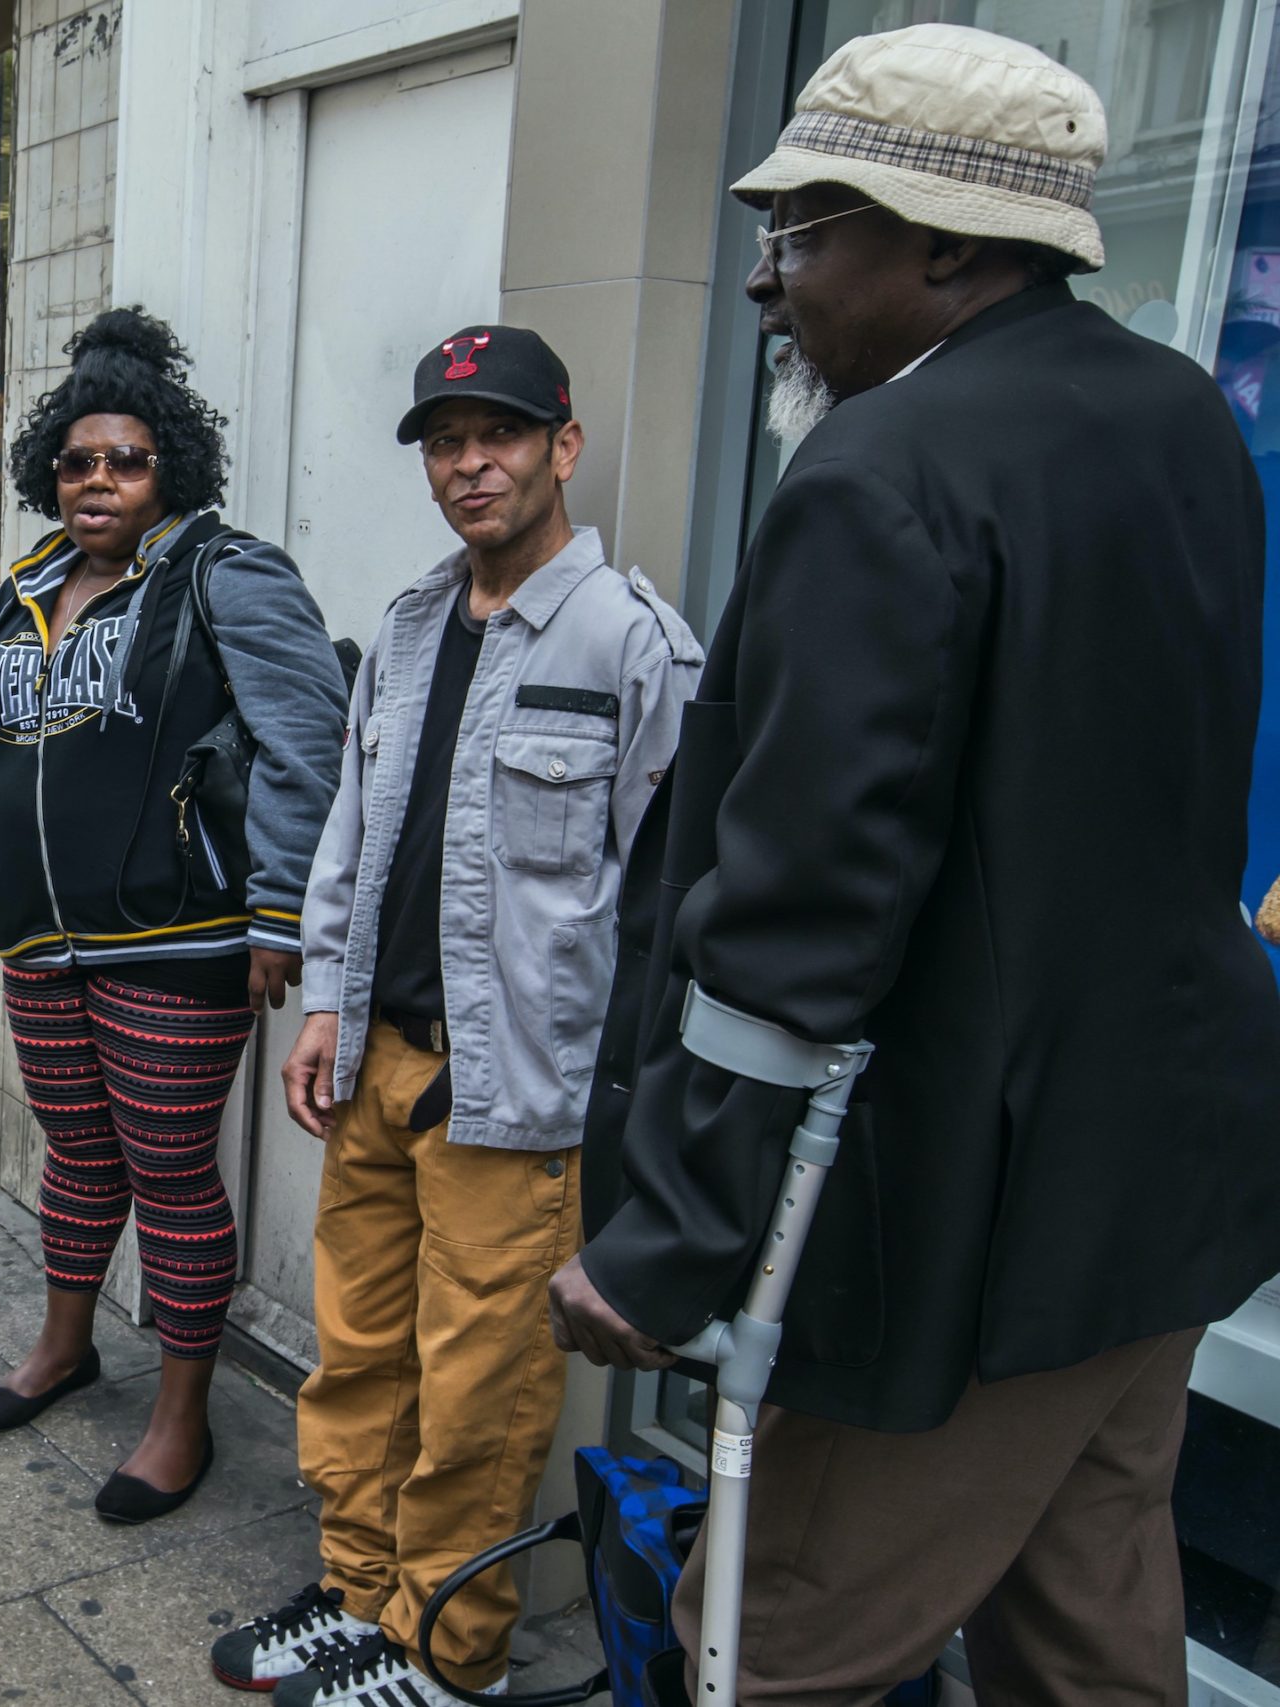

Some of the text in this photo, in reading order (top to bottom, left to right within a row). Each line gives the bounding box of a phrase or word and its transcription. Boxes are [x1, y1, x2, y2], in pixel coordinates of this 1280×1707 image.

[19, 708, 68, 731] EST. 1910
[47, 723, 64, 734] NEW
[65, 711, 86, 727] YORK
